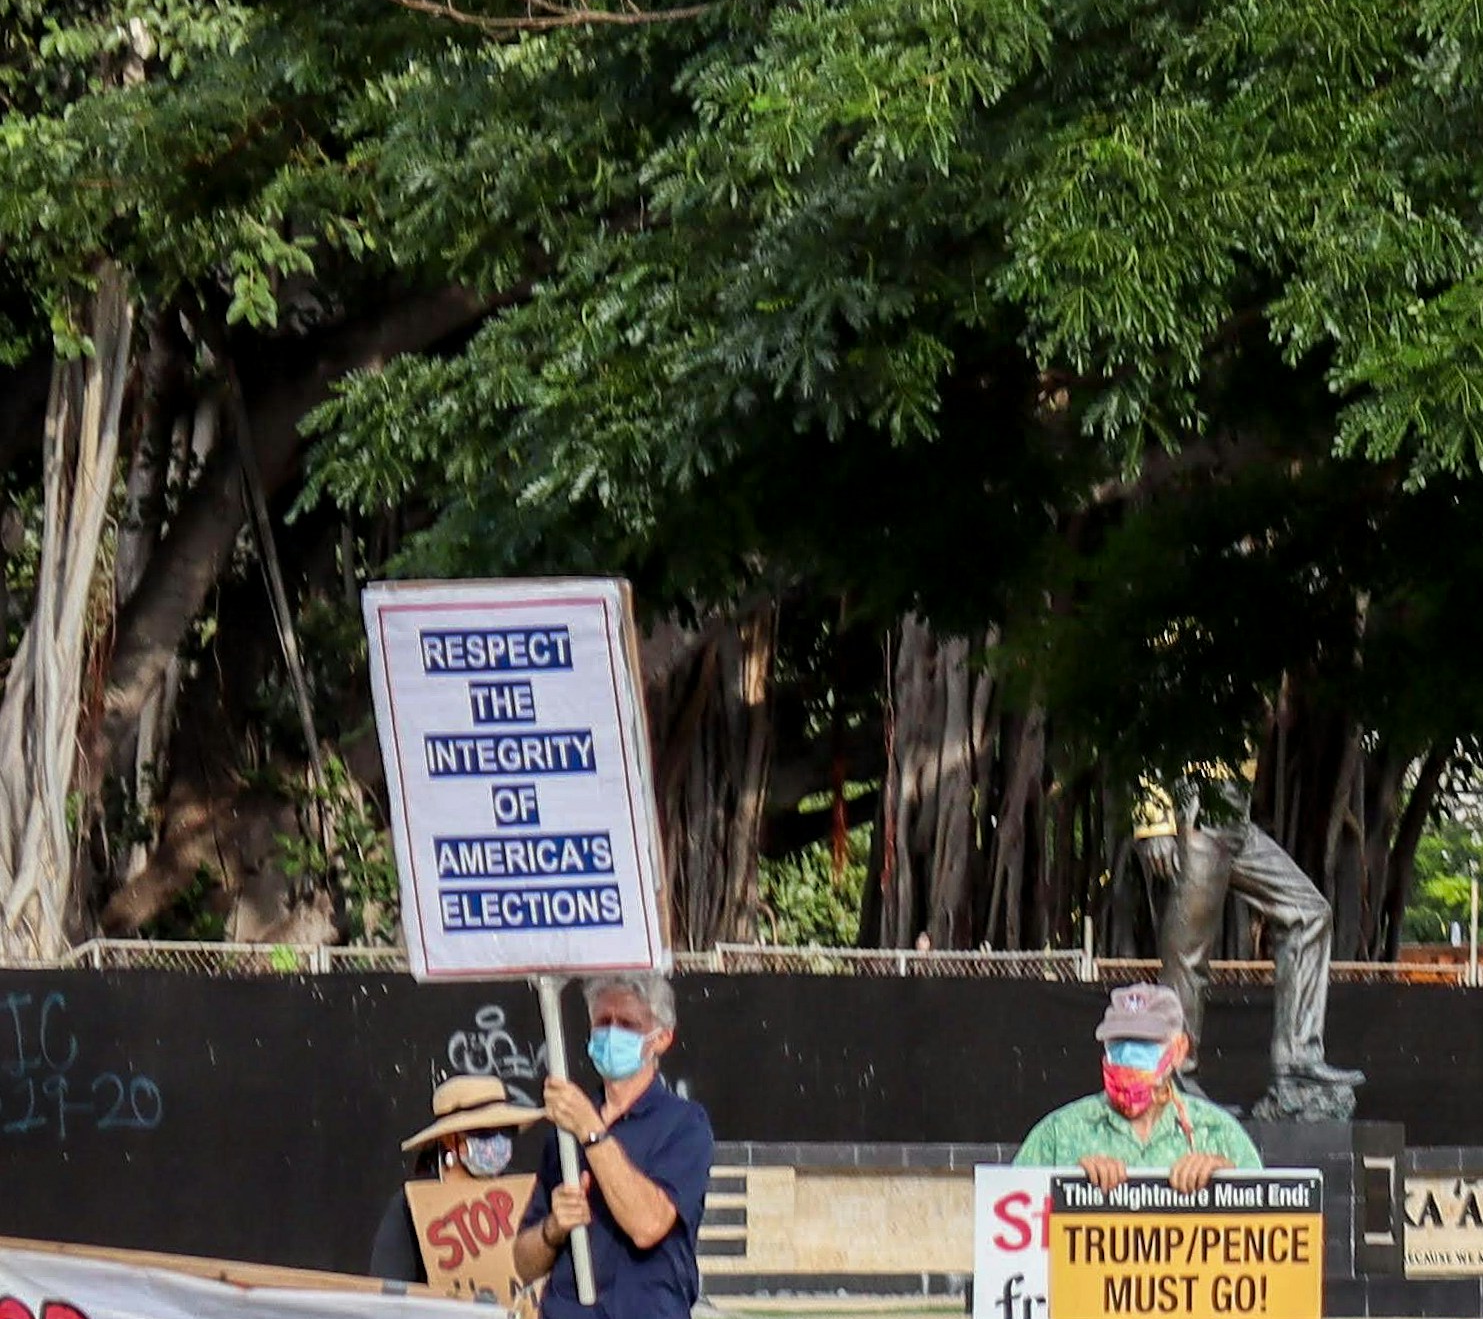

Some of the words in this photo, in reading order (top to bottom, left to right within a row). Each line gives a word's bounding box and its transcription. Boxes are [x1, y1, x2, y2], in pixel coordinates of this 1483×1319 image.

[422, 631, 571, 670] RESPECT
[472, 683, 535, 720] THE
[427, 734, 594, 773] INTEGRITY
[495, 787, 538, 823] OF
[439, 836, 614, 876] AMERICA'S
[442, 886, 622, 928] ELECTIONS
[1063, 1182, 1104, 1206] This
[1215, 1183, 1263, 1206] Must
[426, 1189, 515, 1270] STOP
[1064, 1225, 1310, 1265] TRUMP/PENCE
[1103, 1275, 1198, 1314] MUST
[1212, 1274, 1268, 1314] GO!
